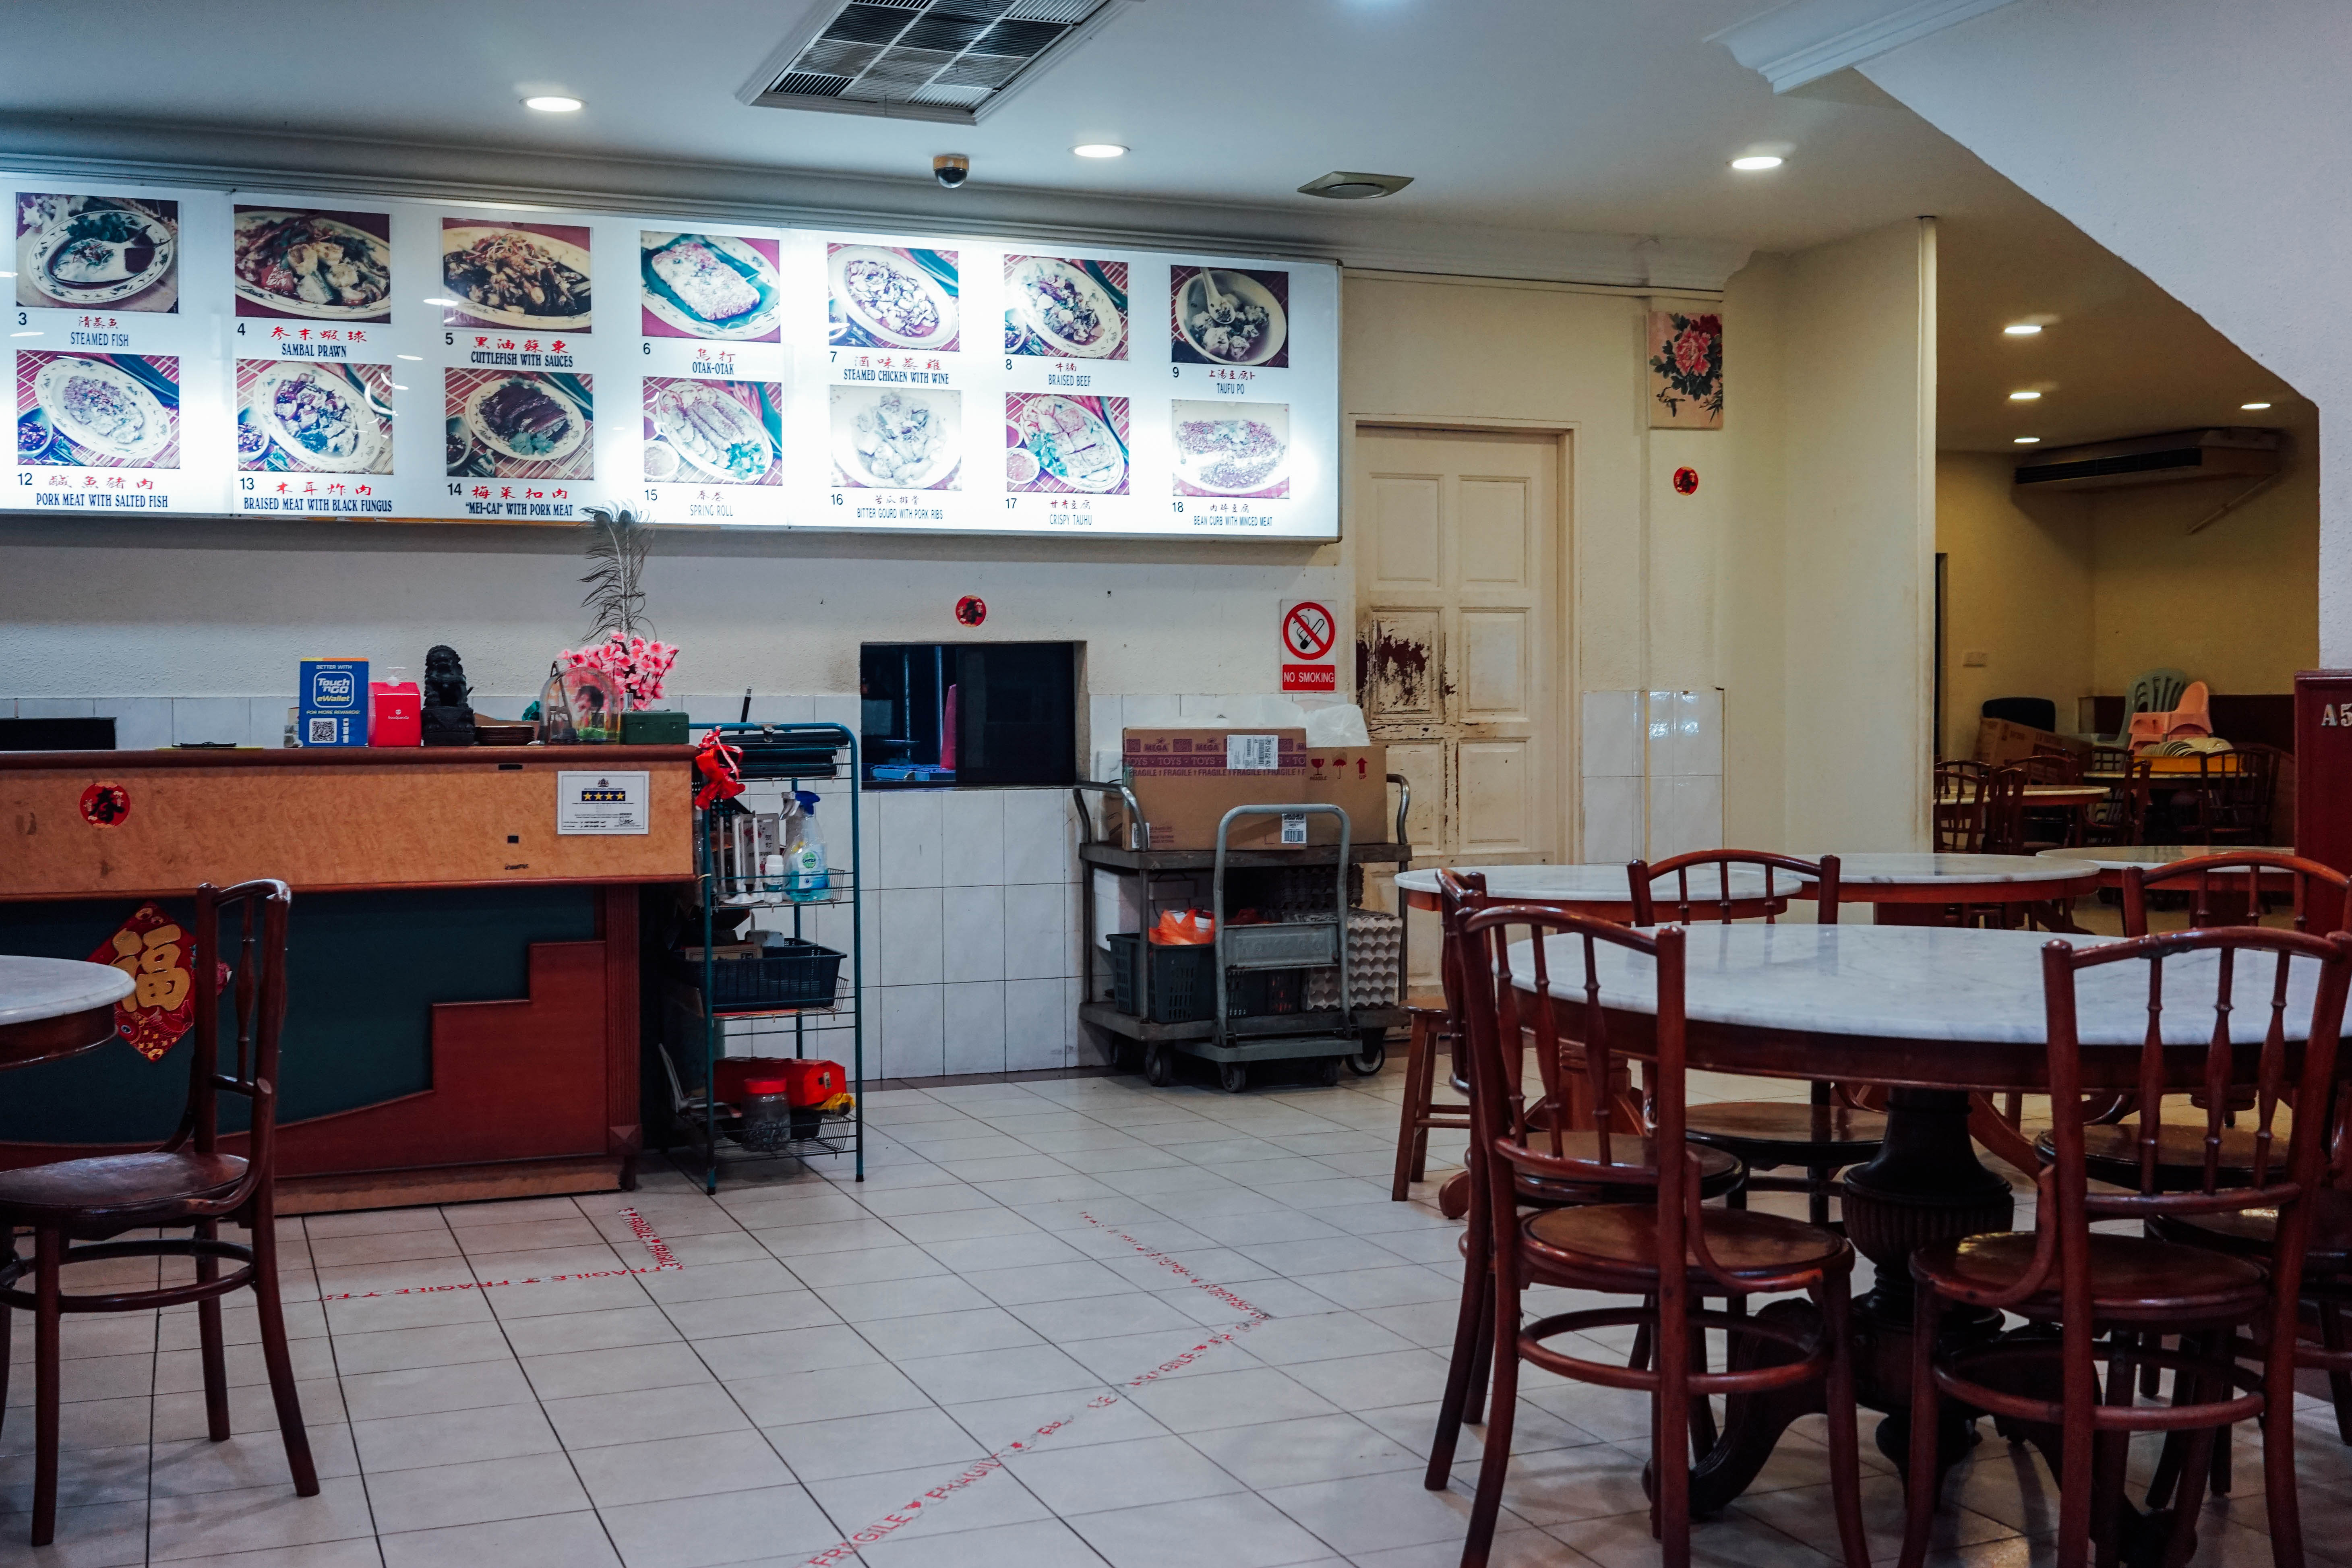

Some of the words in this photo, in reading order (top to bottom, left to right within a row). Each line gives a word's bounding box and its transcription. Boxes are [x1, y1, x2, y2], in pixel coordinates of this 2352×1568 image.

[18, 312, 27, 325] 3
[237, 323, 246, 335] 4
[70, 332, 108, 345] STEAMED
[112, 334, 129, 346] FISH
[445, 333, 453, 345] 5
[282, 343, 314, 356] SAMBAL
[318, 345, 346, 357] PRAWN
[643, 343, 650, 354] 6
[471, 351, 517, 365] CUTTLEFISH
[520, 354, 541, 366] WITH
[545, 355, 573, 367] SAUCES
[830, 351, 837, 363] 7
[692, 362, 734, 374] OTAK-OTAK
[1006, 359, 1012, 370] 8
[844, 369, 875, 381] STEAMED
[878, 370, 908, 382] CHICKEN
[910, 372, 928, 383] WITH
[932, 373, 949, 384] WINE
[1173, 367, 1179, 378] 9
[1049, 374, 1074, 386] BRAISED
[1076, 376, 1091, 386] BEEF
[1217, 383, 1235, 394] TAUFU
[1237, 384, 1244, 394] PO
[17, 473, 33, 485] 12
[240, 478, 254, 490] 13
[447, 483, 462, 495] 14
[645, 489, 658, 501] 15
[36, 493, 59, 505] PORK
[62, 494, 85, 506] MEAT
[89, 494, 112, 506] WITH
[115, 495, 145, 507] SALTED
[149, 495, 168, 507] FISH
[244, 497, 279, 510] BRAISED
[282, 499, 303, 510] MEAT
[307, 499, 329, 511] WITH
[332, 499, 358, 511] BLACK
[361, 500, 392, 512] FUNGUS
[831, 494, 843, 505] 16
[1005, 498, 1017, 509] 17
[507, 503, 527, 515] WITH
[530, 504, 550, 515] PORK
[553, 504, 573, 516] MEAT
[690, 505, 714, 516] SPRING
[717, 505, 733, 516] ROLL
[1172, 502, 1183, 512] 18
[857, 508, 876, 518] BITTER
[878, 509, 897, 518] GOURD
[900, 509, 912, 519] WITH
[914, 509, 929, 519] PORK
[931, 509, 943, 519] RIBS
[1049, 514, 1070, 525] CRISPY
[1073, 515, 1092, 525] TAUHU
[1194, 516, 1207, 525] BEAN
[1209, 516, 1223, 525] CURB
[1225, 516, 1238, 526] WITH
[1239, 517, 1258, 526] MINCED
[1260, 517, 1272, 526] MEAT
[317, 678, 350, 686] Touch
[1284, 672, 1295, 683] NO
[1298, 672, 1335, 683] SMOKING
[1191, 757, 1215, 765] TOYS
[109, 925, 190, 1012] 福
